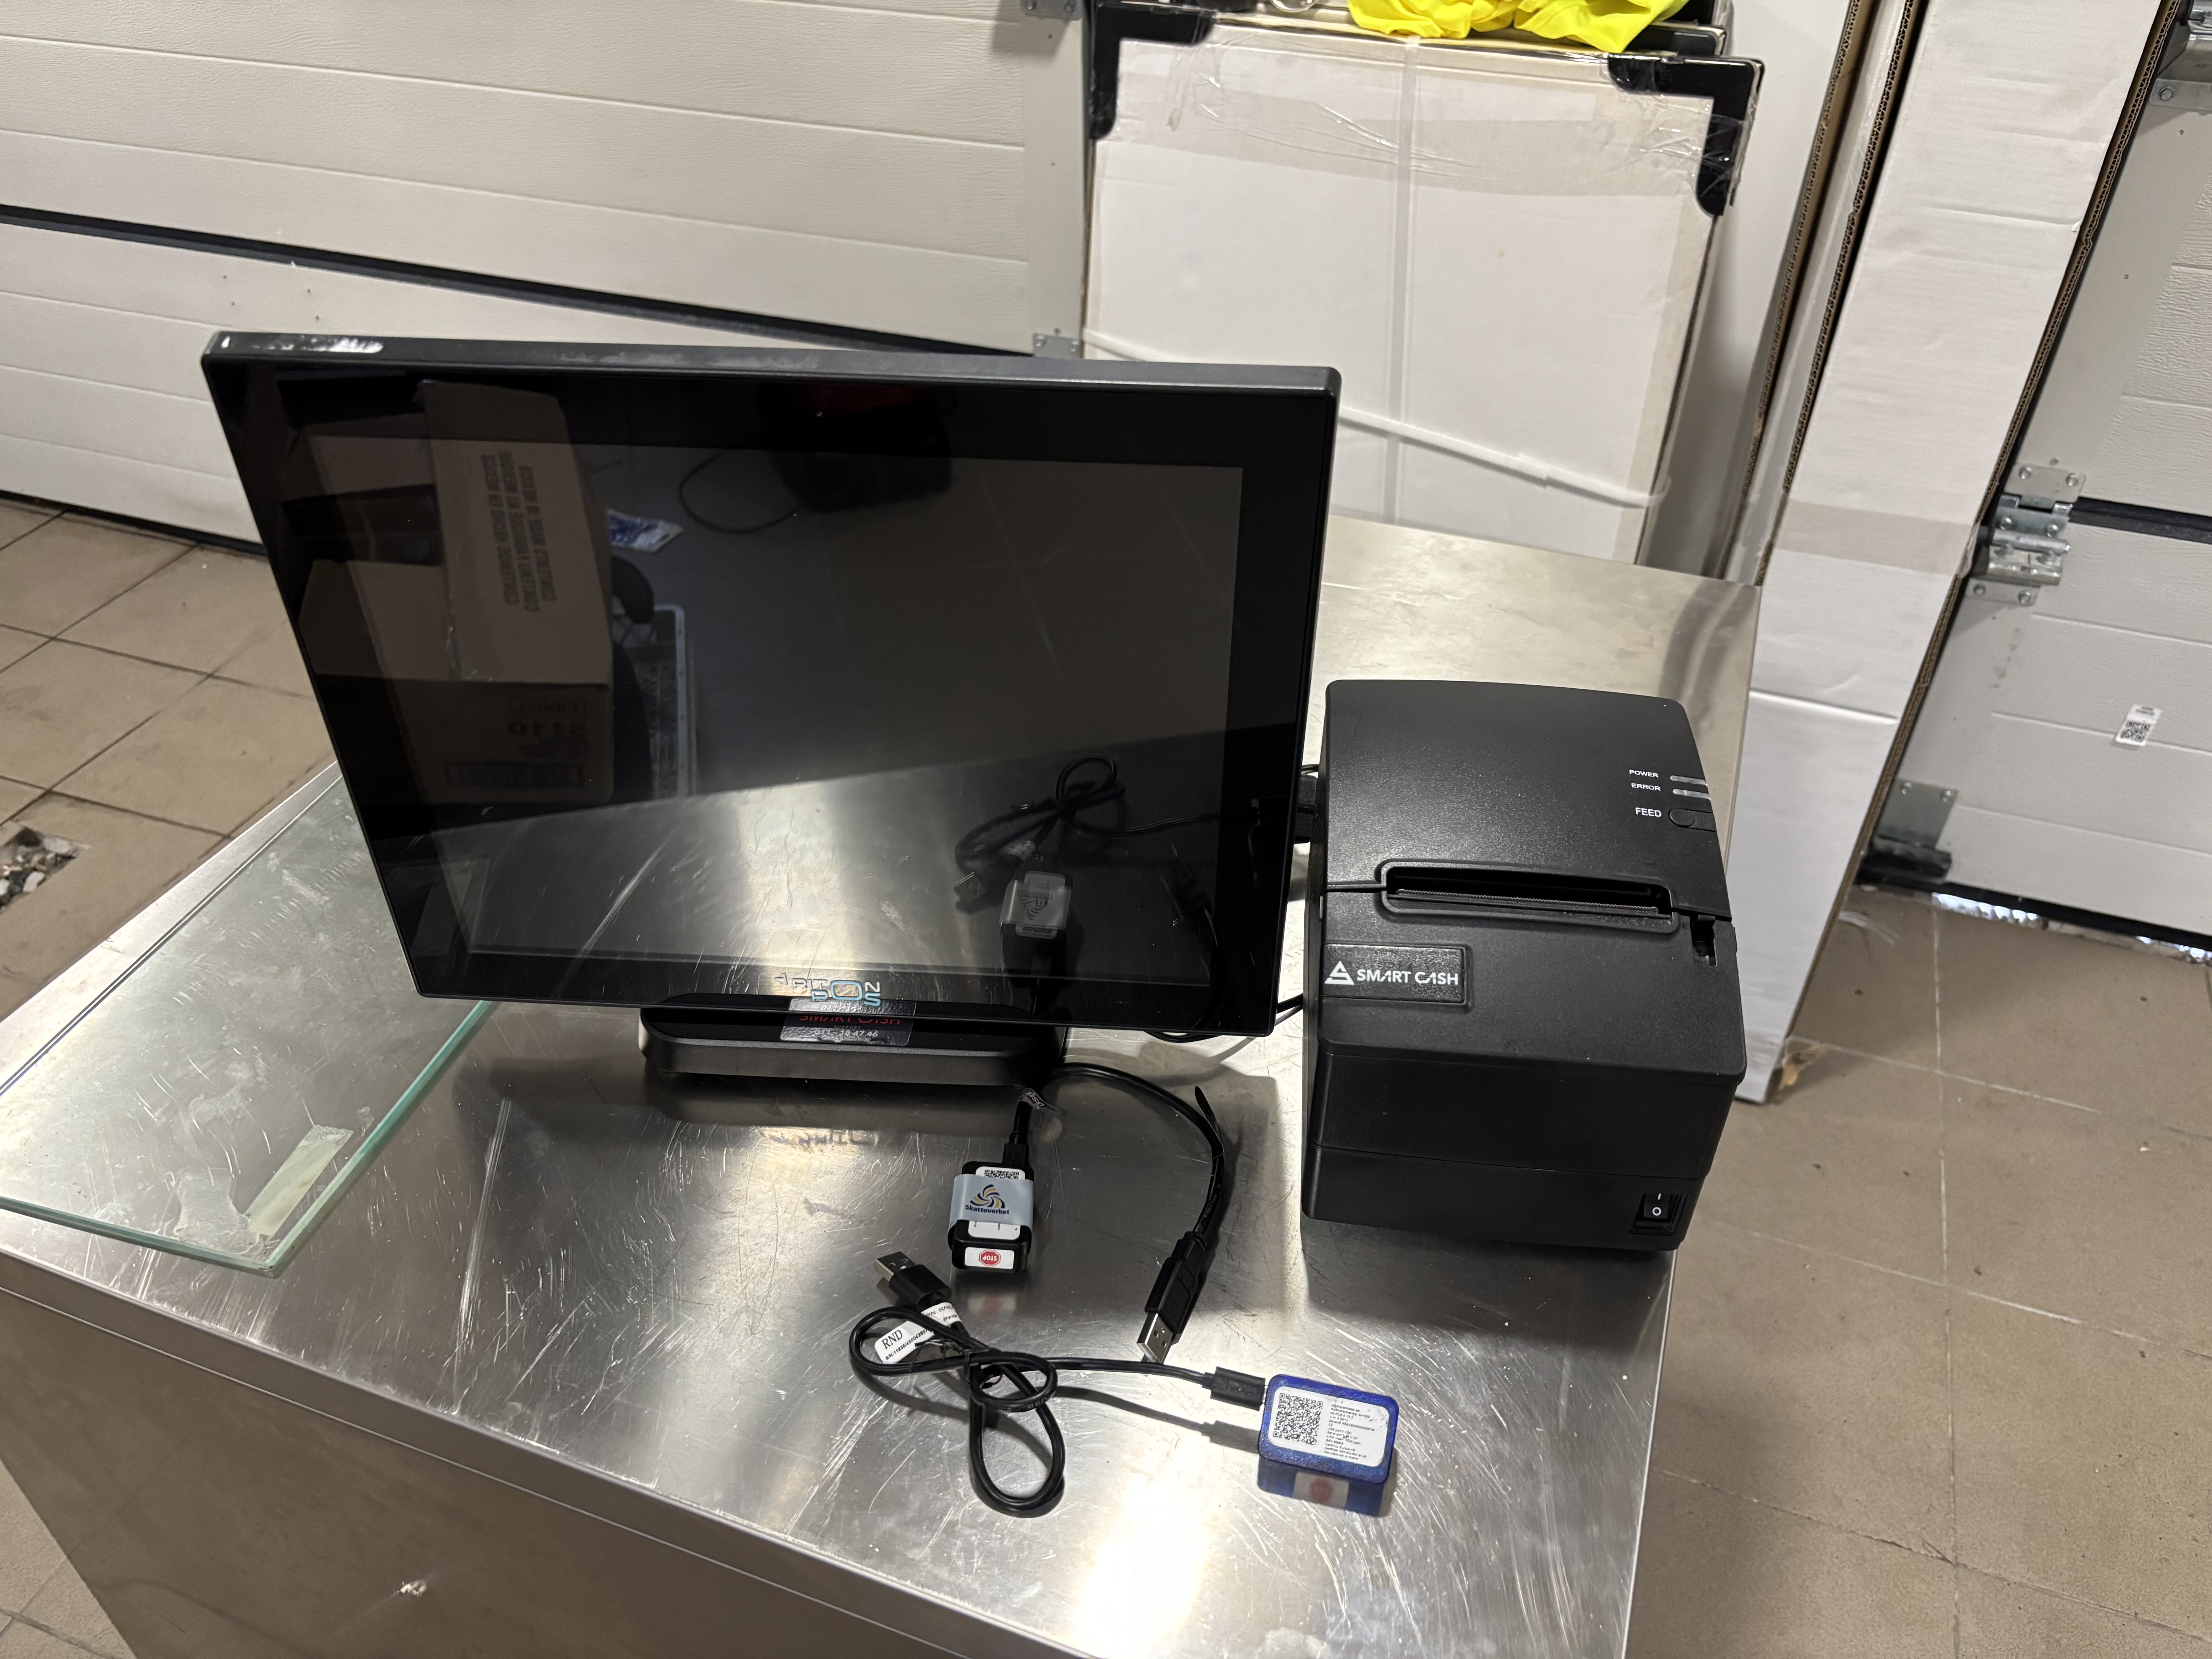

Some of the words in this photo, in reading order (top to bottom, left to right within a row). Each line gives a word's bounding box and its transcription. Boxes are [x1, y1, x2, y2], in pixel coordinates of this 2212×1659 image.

[1629, 769, 1659, 778] POWER
[1631, 783, 1661, 791] ERROR
[1635, 807, 1661, 817] FEED
[1357, 969, 1412, 983] SMART
[1414, 971, 1458, 985] CASH
[965, 1205, 1010, 1214] Skatteverket
[881, 1330, 903, 1350] RND
